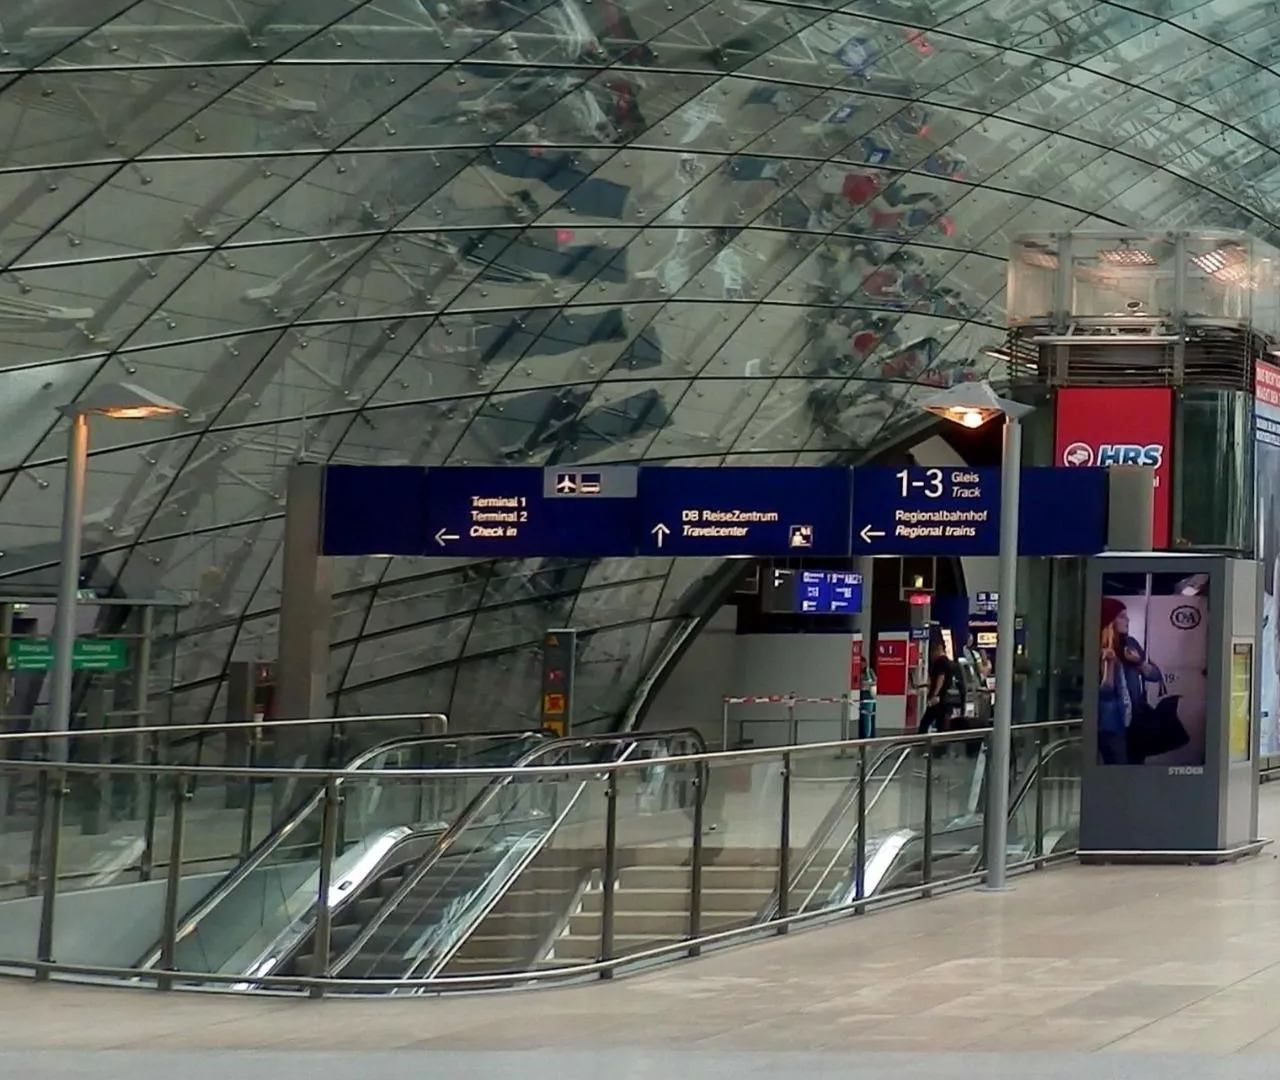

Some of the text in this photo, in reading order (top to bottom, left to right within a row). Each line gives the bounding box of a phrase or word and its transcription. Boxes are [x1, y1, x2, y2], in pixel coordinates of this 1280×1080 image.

[1098, 444, 1163, 468] HRS
[951, 471, 980, 483] Gleis
[896, 469, 944, 498] 1-3
[951, 486, 981, 498] Track
[470, 496, 527, 507] Terminal 1
[470, 510, 528, 522] Terminal 2
[682, 510, 779, 522] DB ReiseZentrum
[895, 509, 988, 523] Regionalbahnhof
[469, 525, 517, 537] Check in
[682, 525, 749, 537] Travelcenter
[895, 525, 976, 538] Regional trains
